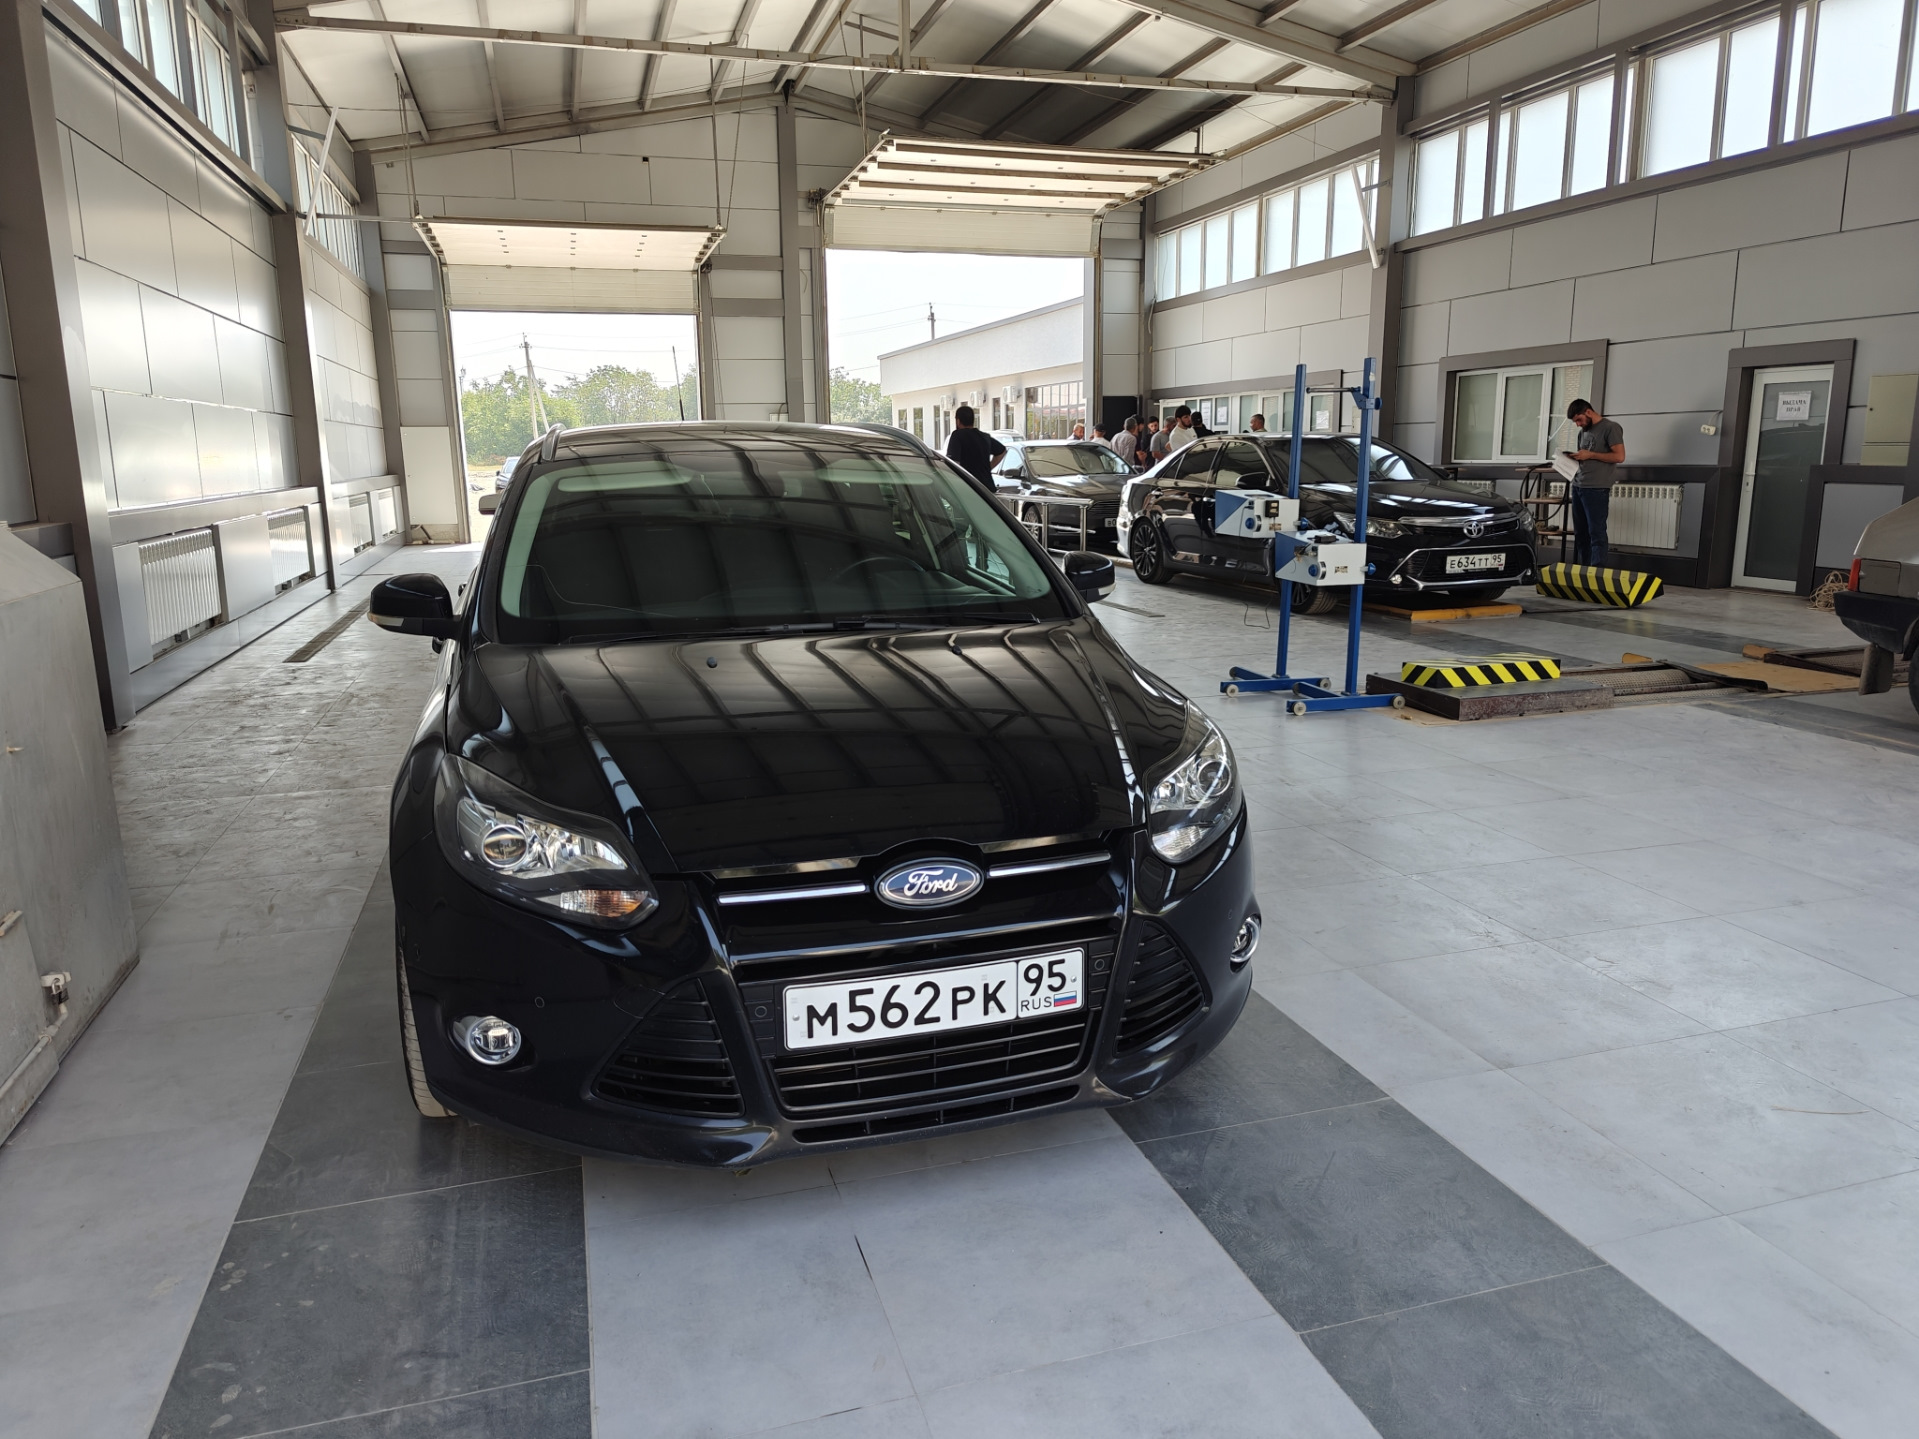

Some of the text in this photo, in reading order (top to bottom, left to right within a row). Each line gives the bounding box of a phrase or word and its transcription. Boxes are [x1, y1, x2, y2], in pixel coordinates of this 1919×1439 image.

[1450, 554, 1502, 569] Е634ТТ 95
[903, 868, 958, 897] Ford
[805, 958, 1067, 1039] М562РК 95
[1020, 996, 1052, 1013] RUS
